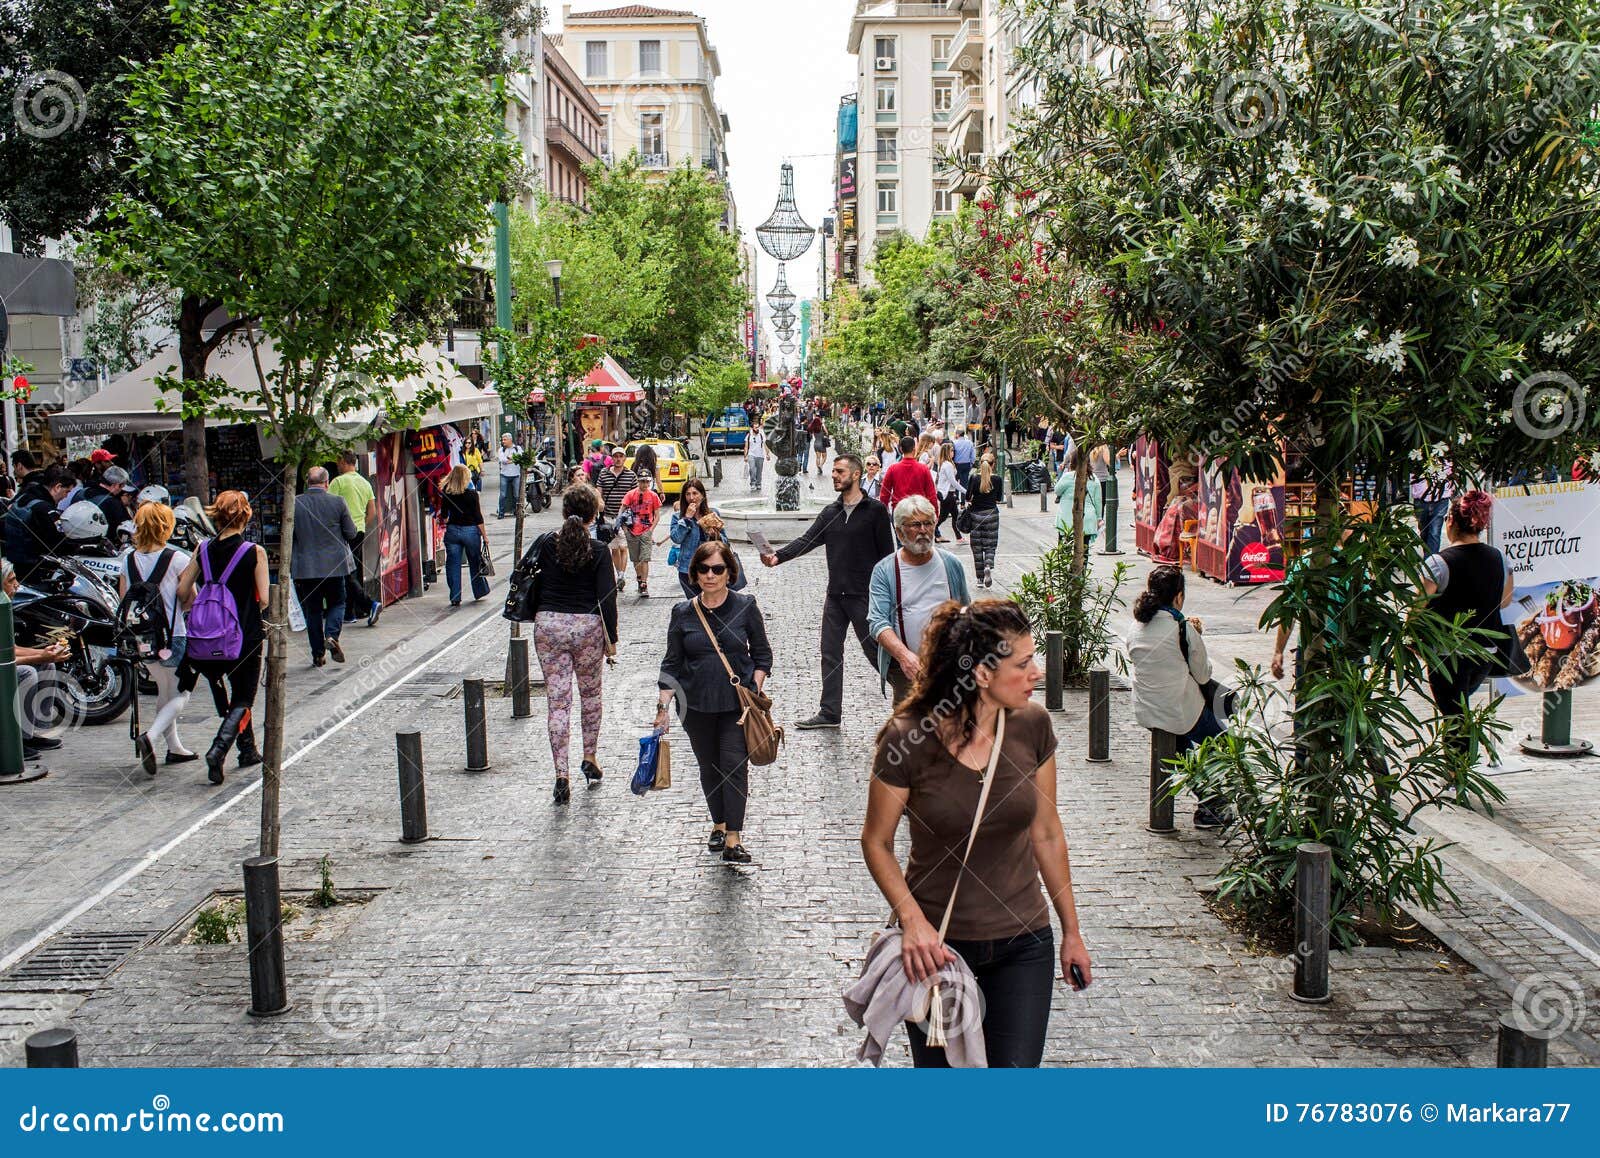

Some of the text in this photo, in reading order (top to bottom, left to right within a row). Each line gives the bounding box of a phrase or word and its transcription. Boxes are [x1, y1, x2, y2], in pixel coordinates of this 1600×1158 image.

[419, 434, 436, 452] 10
[82, 559, 121, 573] POLICE
[1510, 563, 1534, 573] όλης
